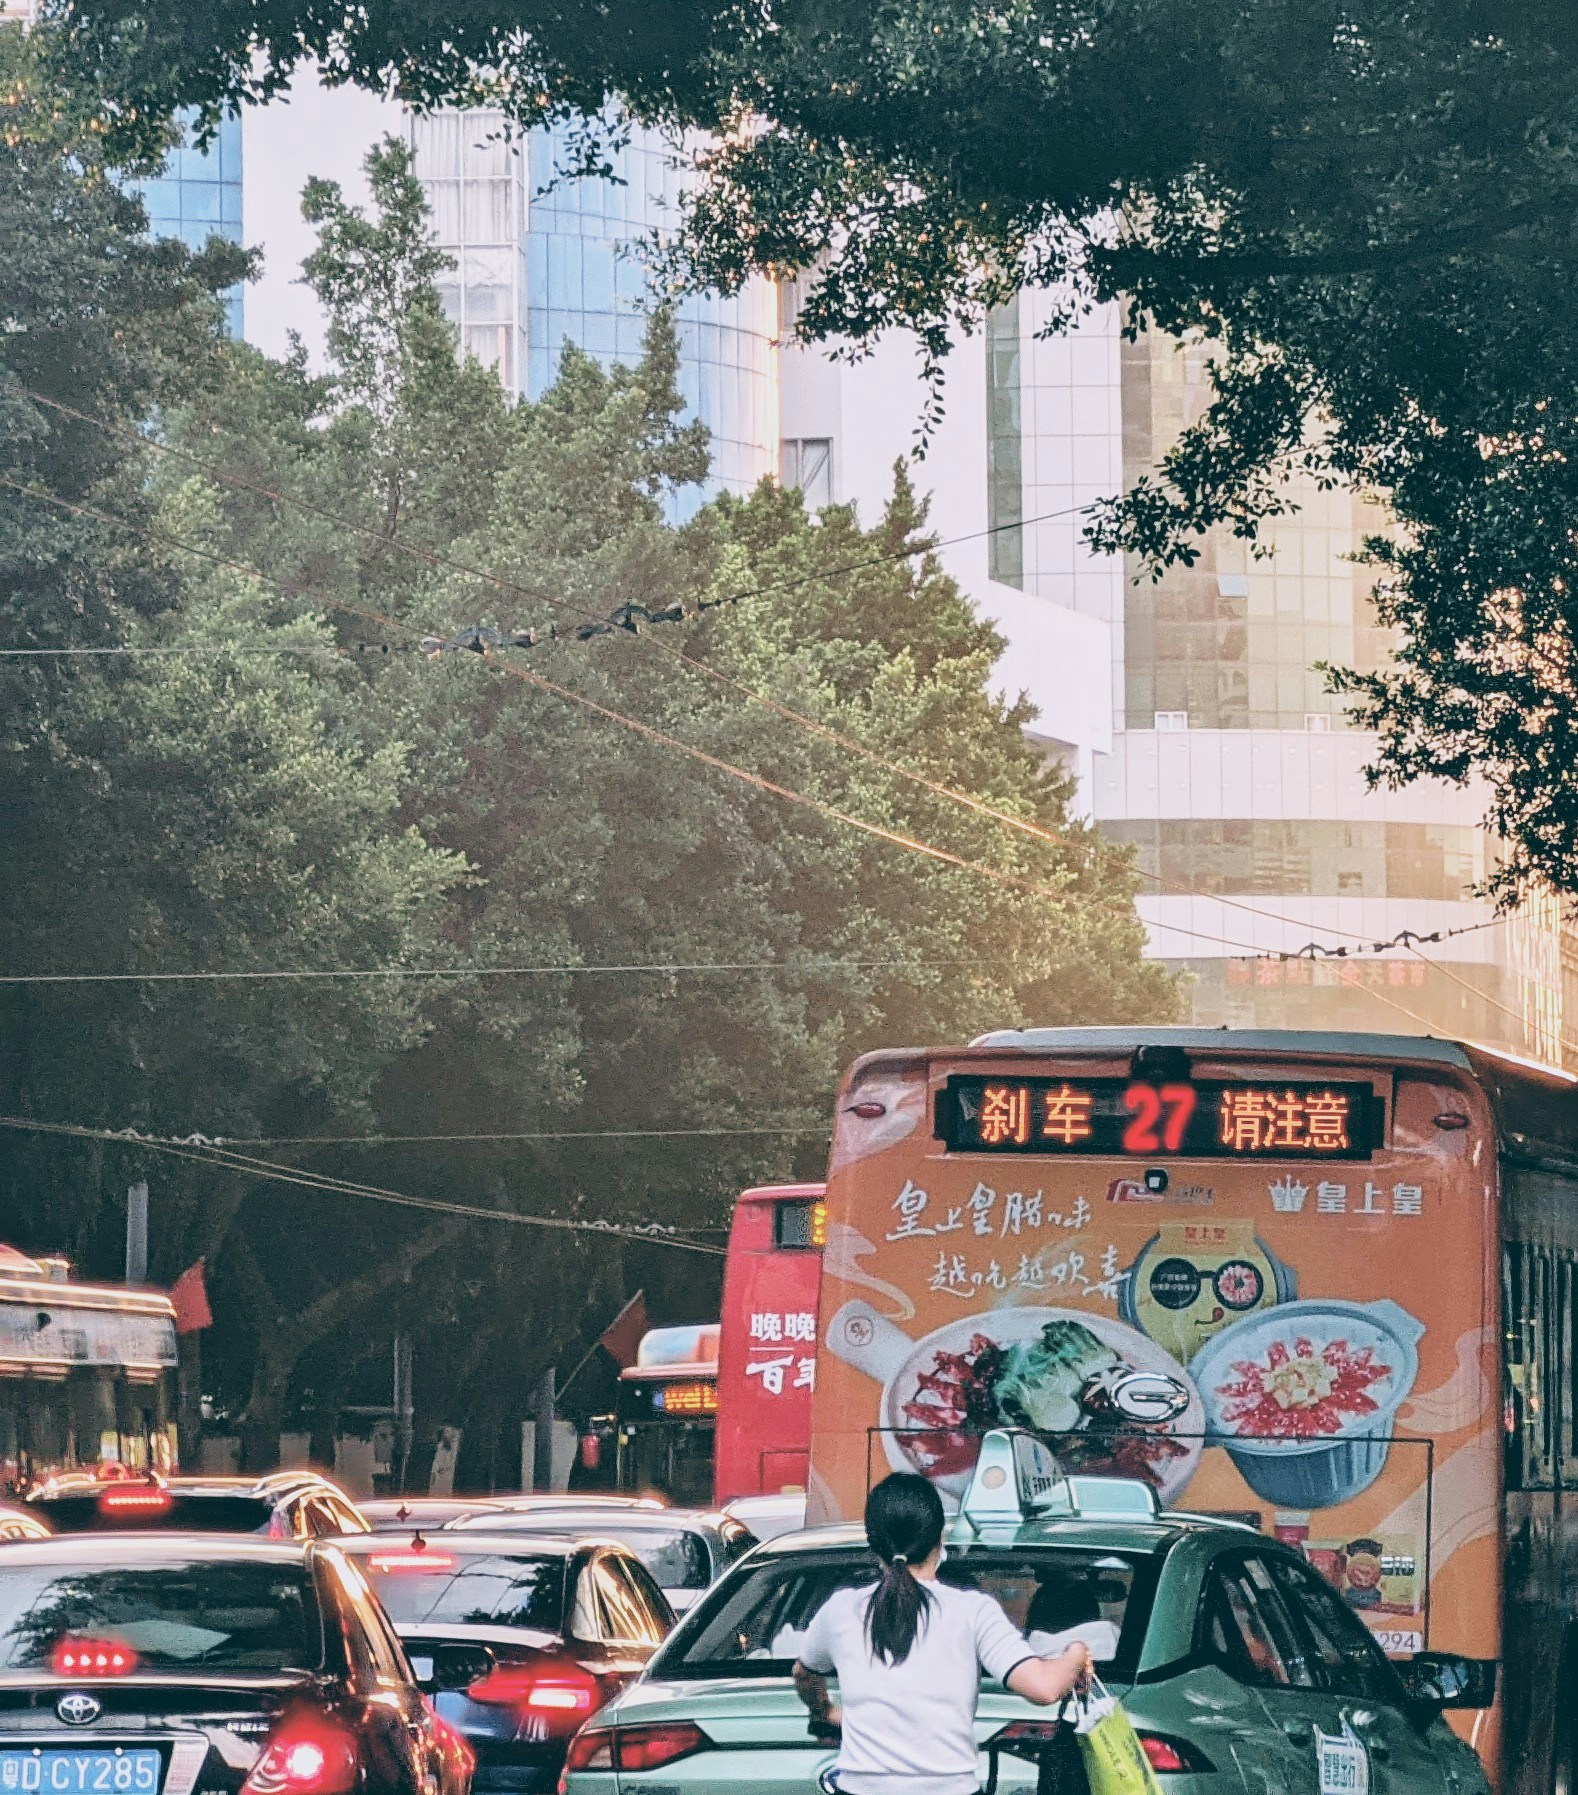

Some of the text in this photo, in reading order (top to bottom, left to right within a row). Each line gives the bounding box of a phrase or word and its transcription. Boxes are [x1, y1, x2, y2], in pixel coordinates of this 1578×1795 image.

[981, 1084, 1349, 1152] 刹车 27 请注意
[1316, 1181, 1423, 1216] 皇上皇
[749, 1312, 816, 1341] 晚晚
